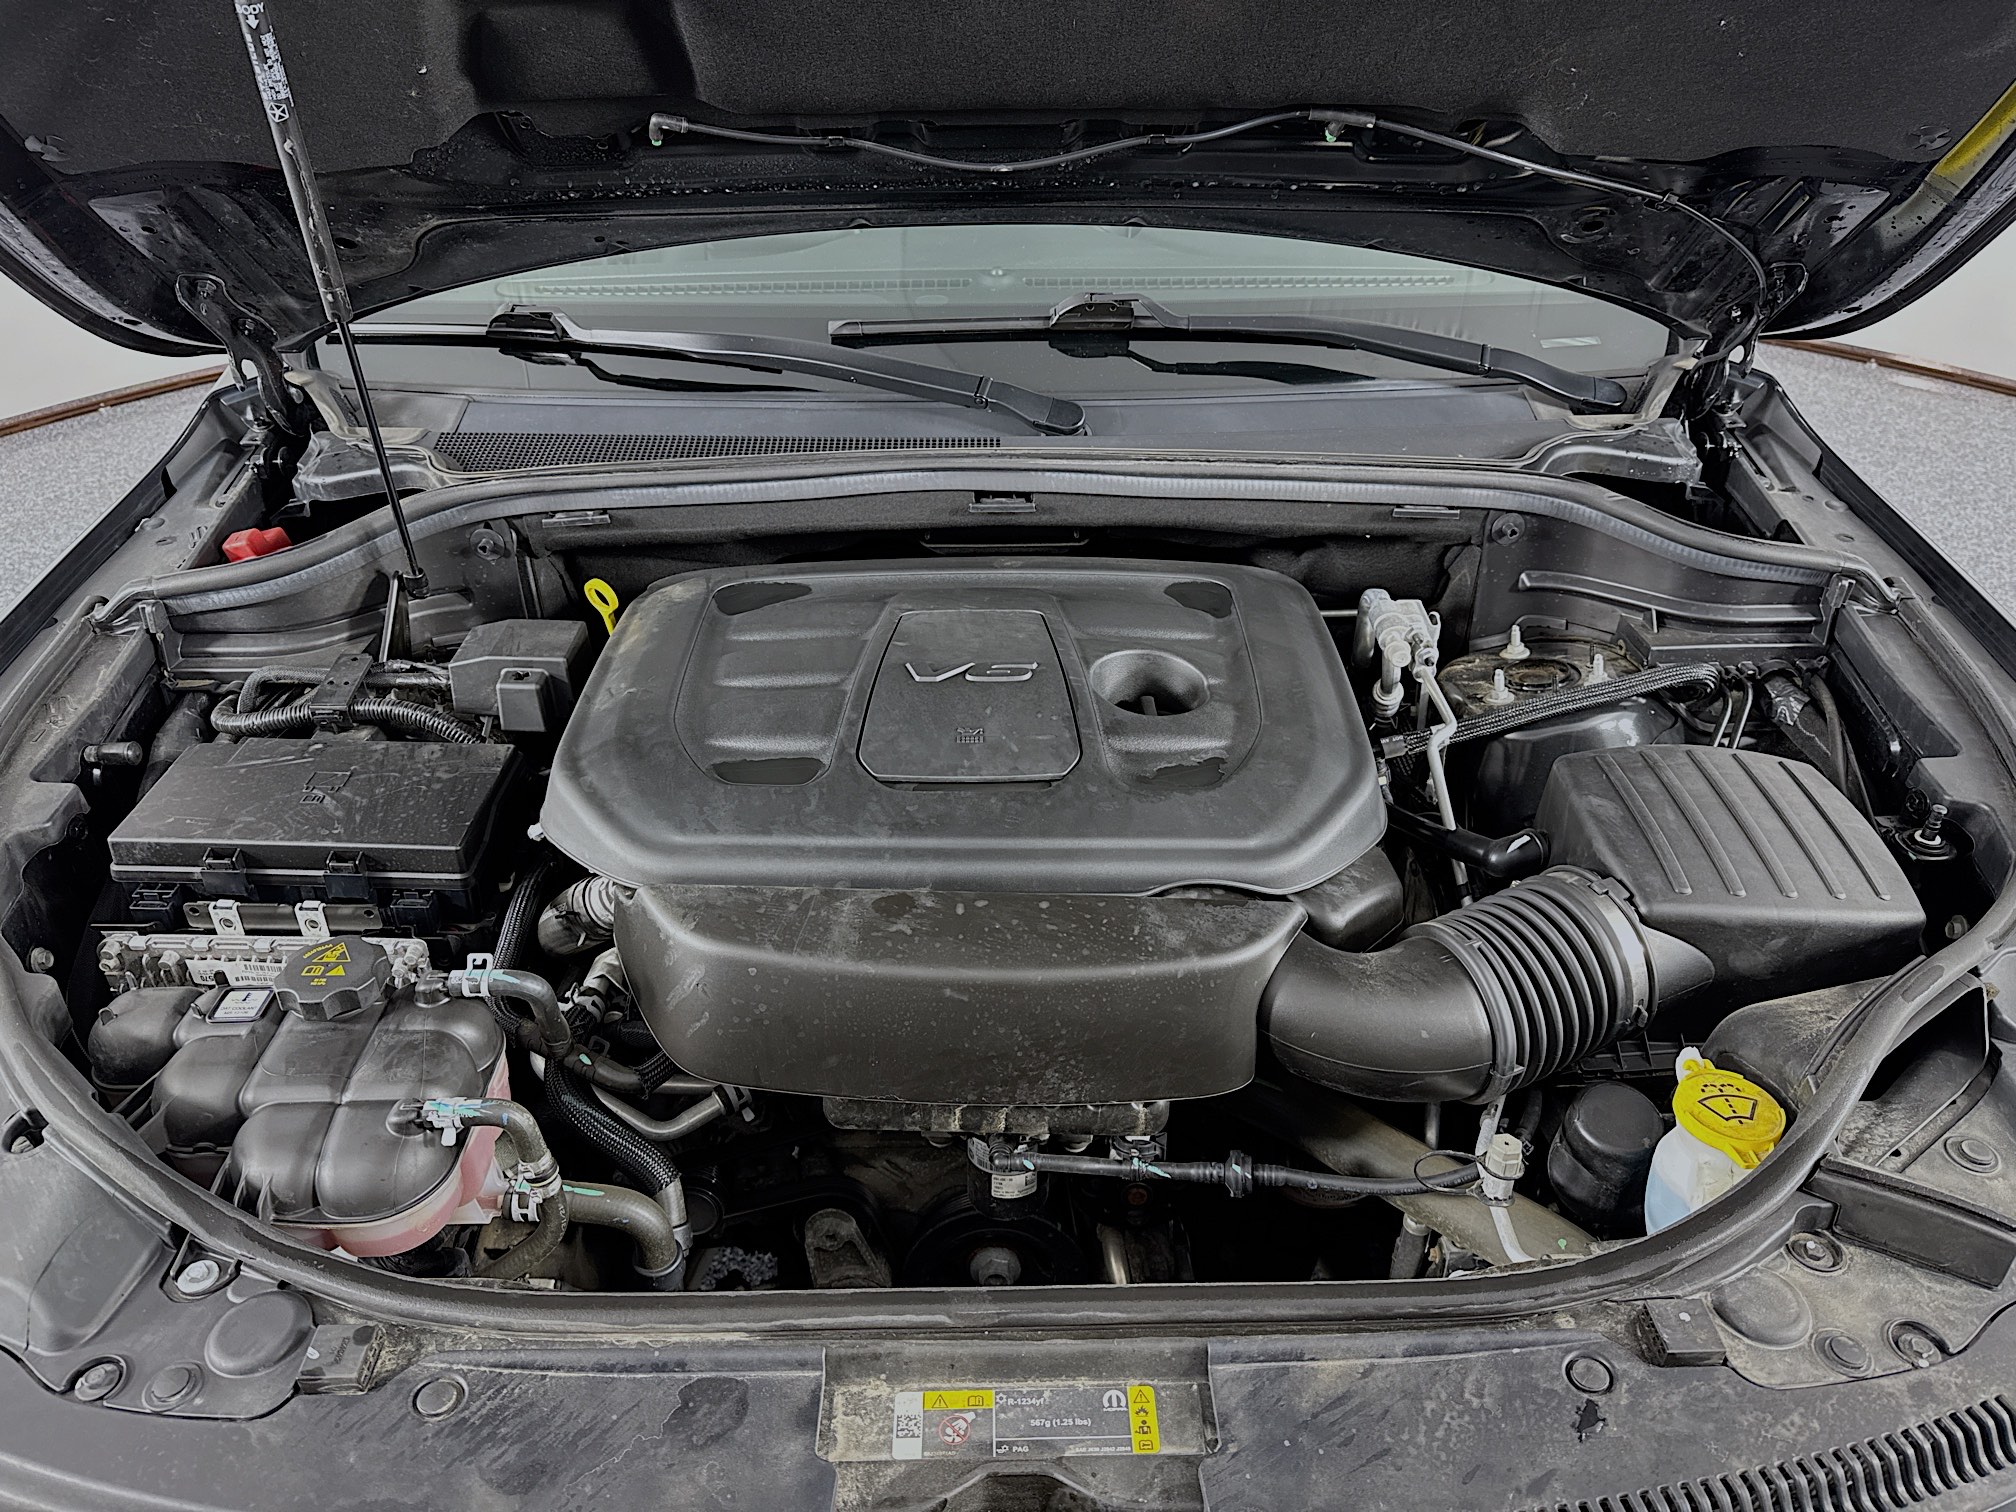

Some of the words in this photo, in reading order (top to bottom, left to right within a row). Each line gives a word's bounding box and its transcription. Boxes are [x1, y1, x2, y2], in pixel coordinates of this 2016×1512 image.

[235, 2, 264, 15] BODY
[905, 661, 1039, 682] V6
[1007, 1397, 1045, 1407] R-1234yf
[1030, 1418, 1051, 1427] 567g
[1052, 1418, 1074, 1427] (1.25
[1074, 1417, 1092, 1427] lbs)
[1012, 1445, 1030, 1453] PAG
